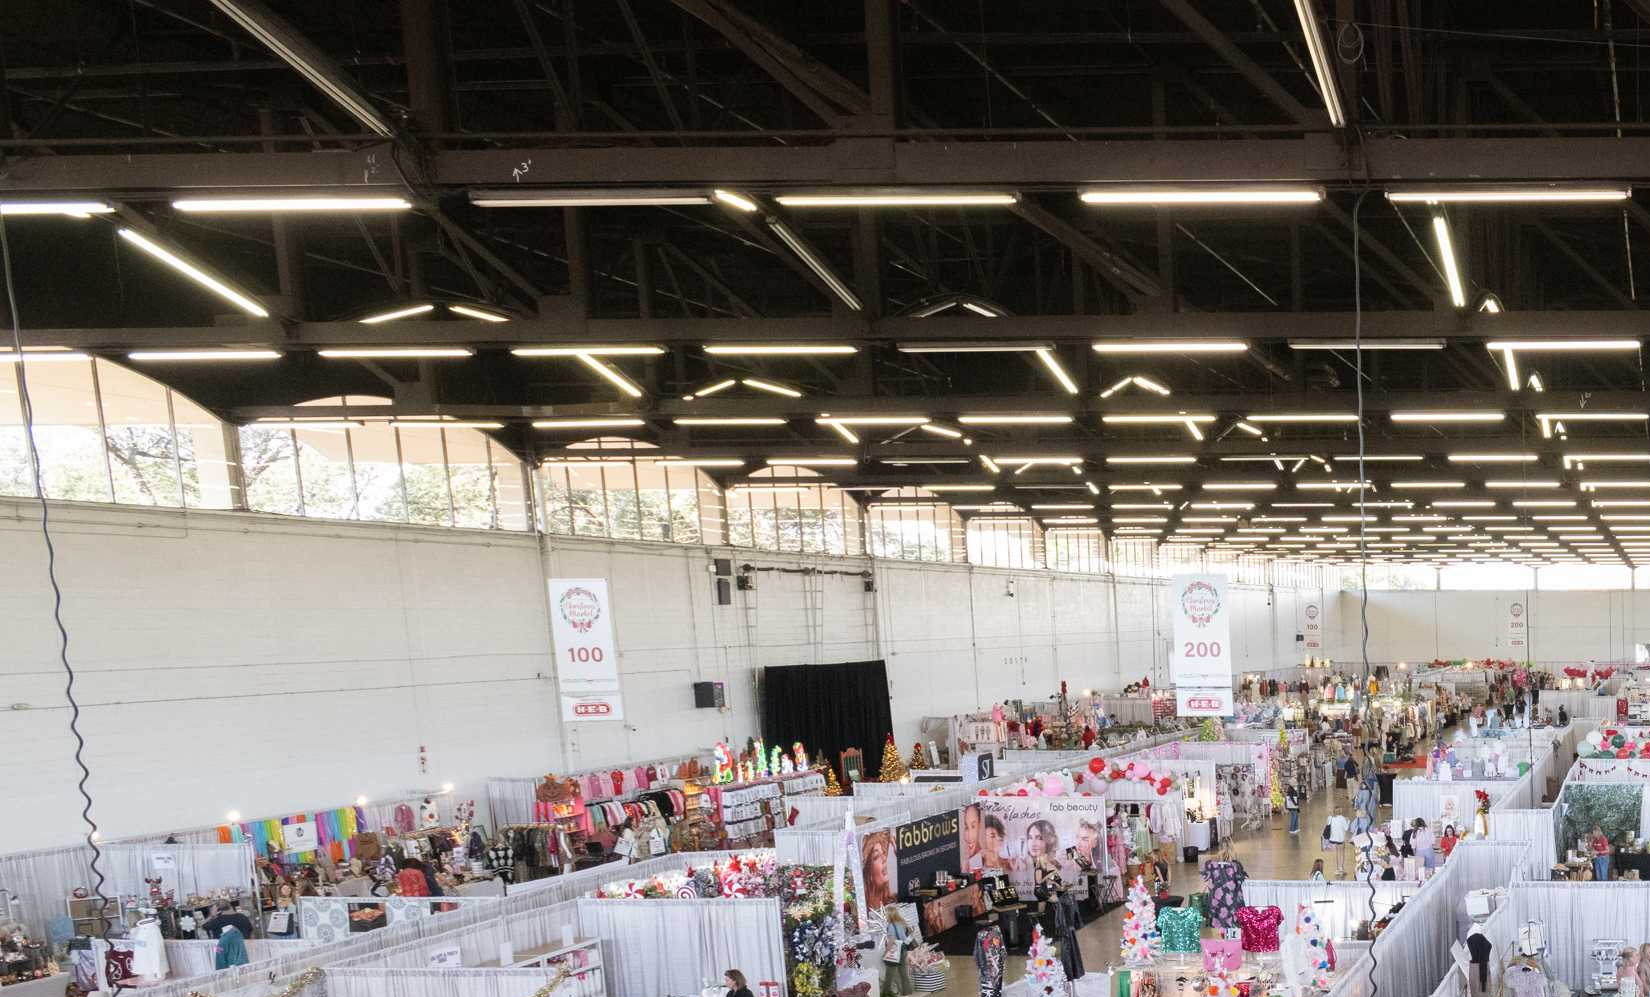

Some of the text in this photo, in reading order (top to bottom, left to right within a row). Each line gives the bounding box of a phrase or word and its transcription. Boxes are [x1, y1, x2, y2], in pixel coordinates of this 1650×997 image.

[568, 646, 604, 663] 100
[1185, 641, 1221, 658] 200
[1049, 801, 1098, 814] fab beauty
[898, 817, 958, 850] fabbrows
